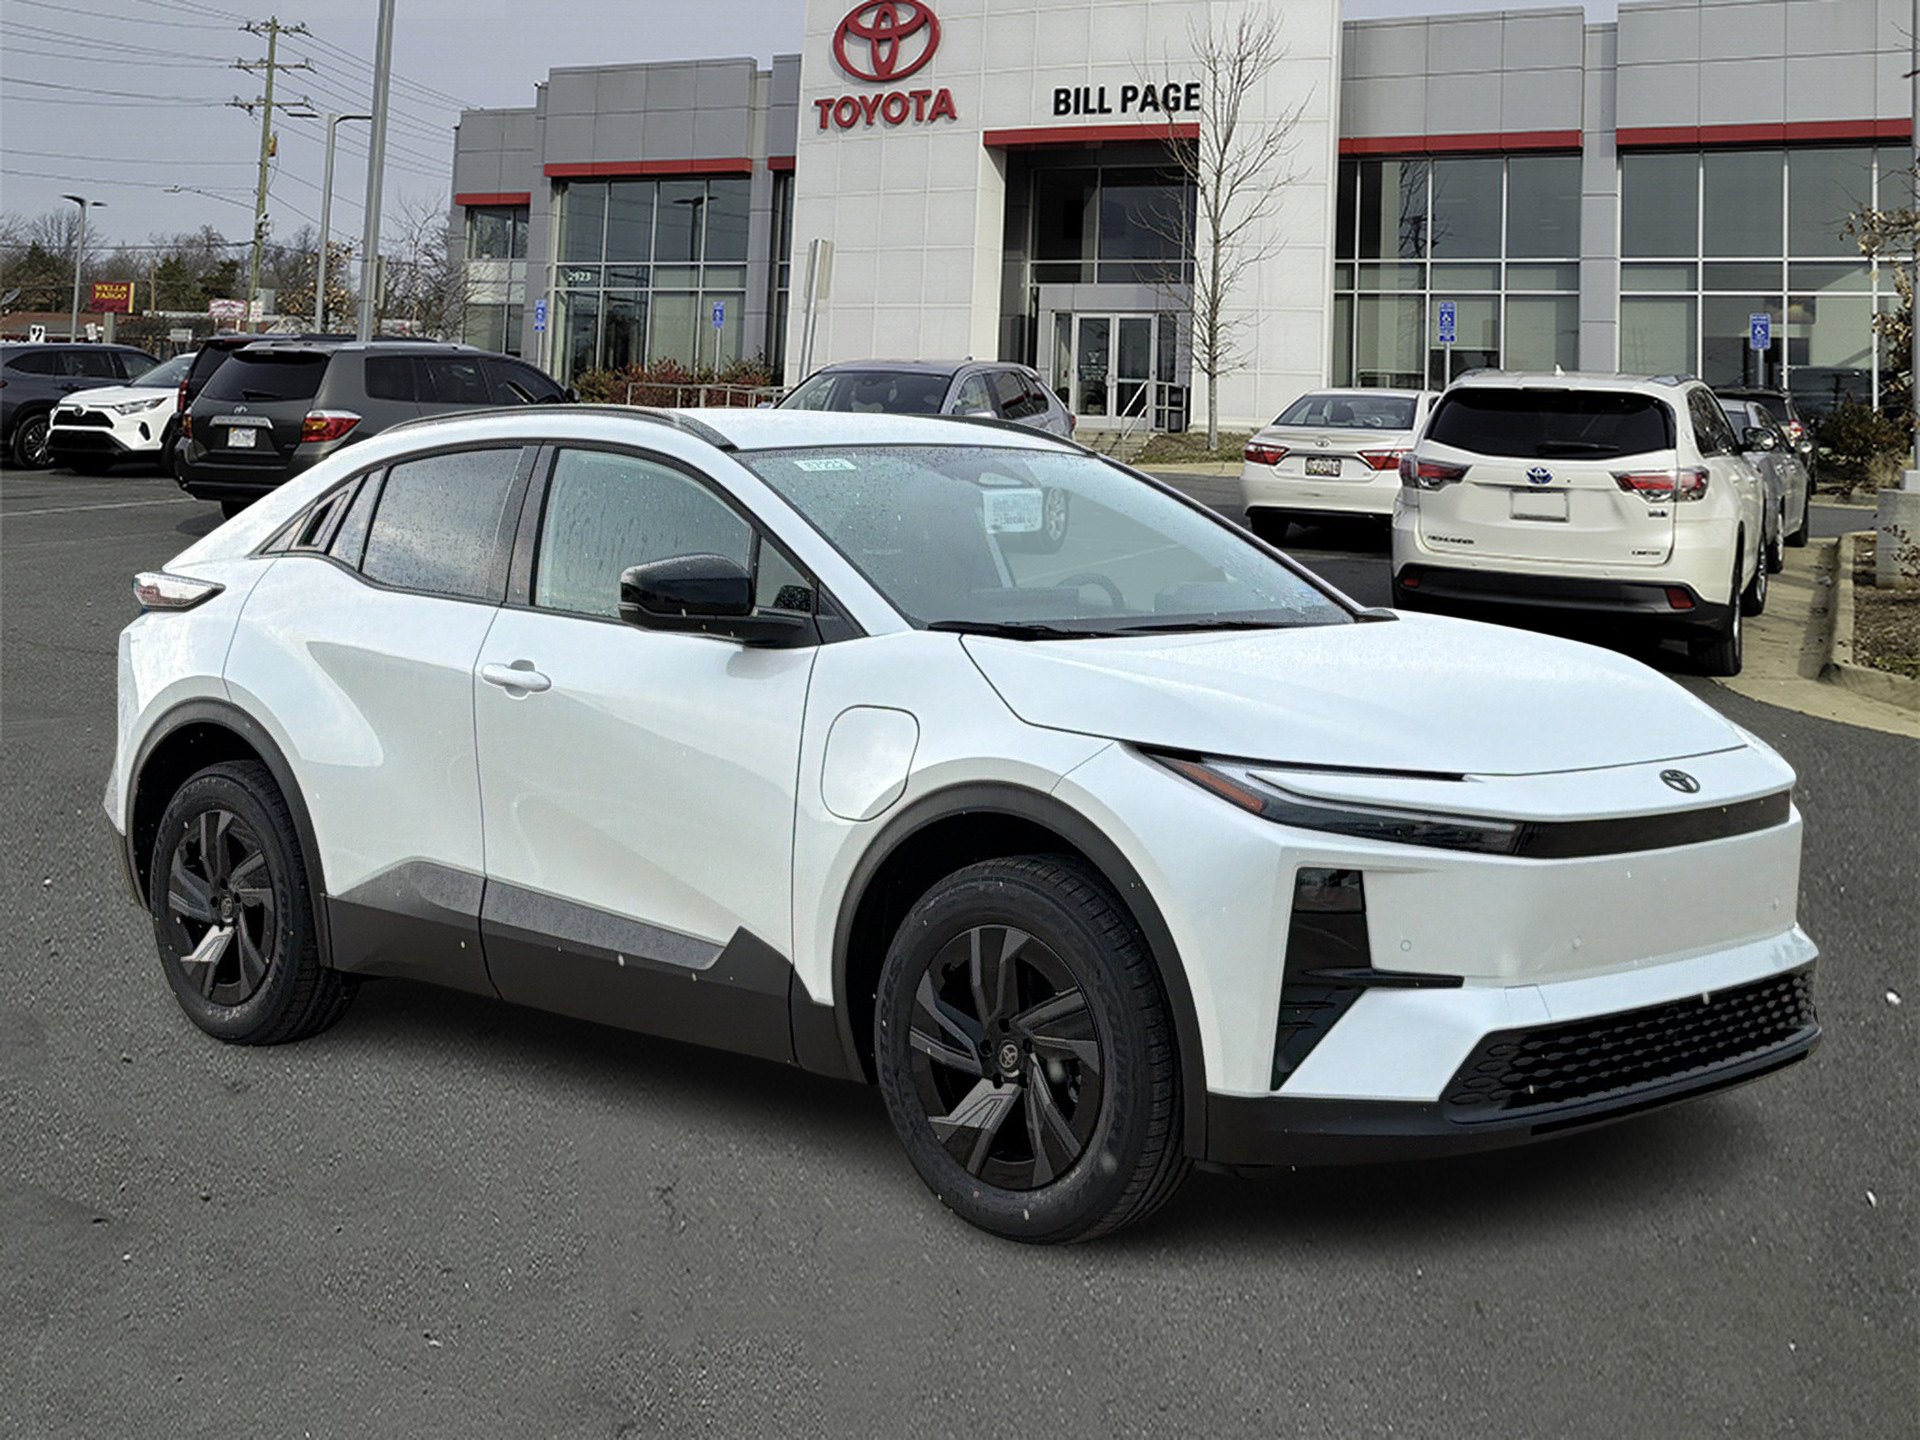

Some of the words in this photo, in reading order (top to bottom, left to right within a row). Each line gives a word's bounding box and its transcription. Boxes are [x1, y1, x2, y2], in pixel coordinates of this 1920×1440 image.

[814, 88, 957, 129] TOYOTA
[1053, 86, 1112, 115] BILL
[1121, 83, 1201, 113] PAGE
[95, 291, 127, 300] FARGO
